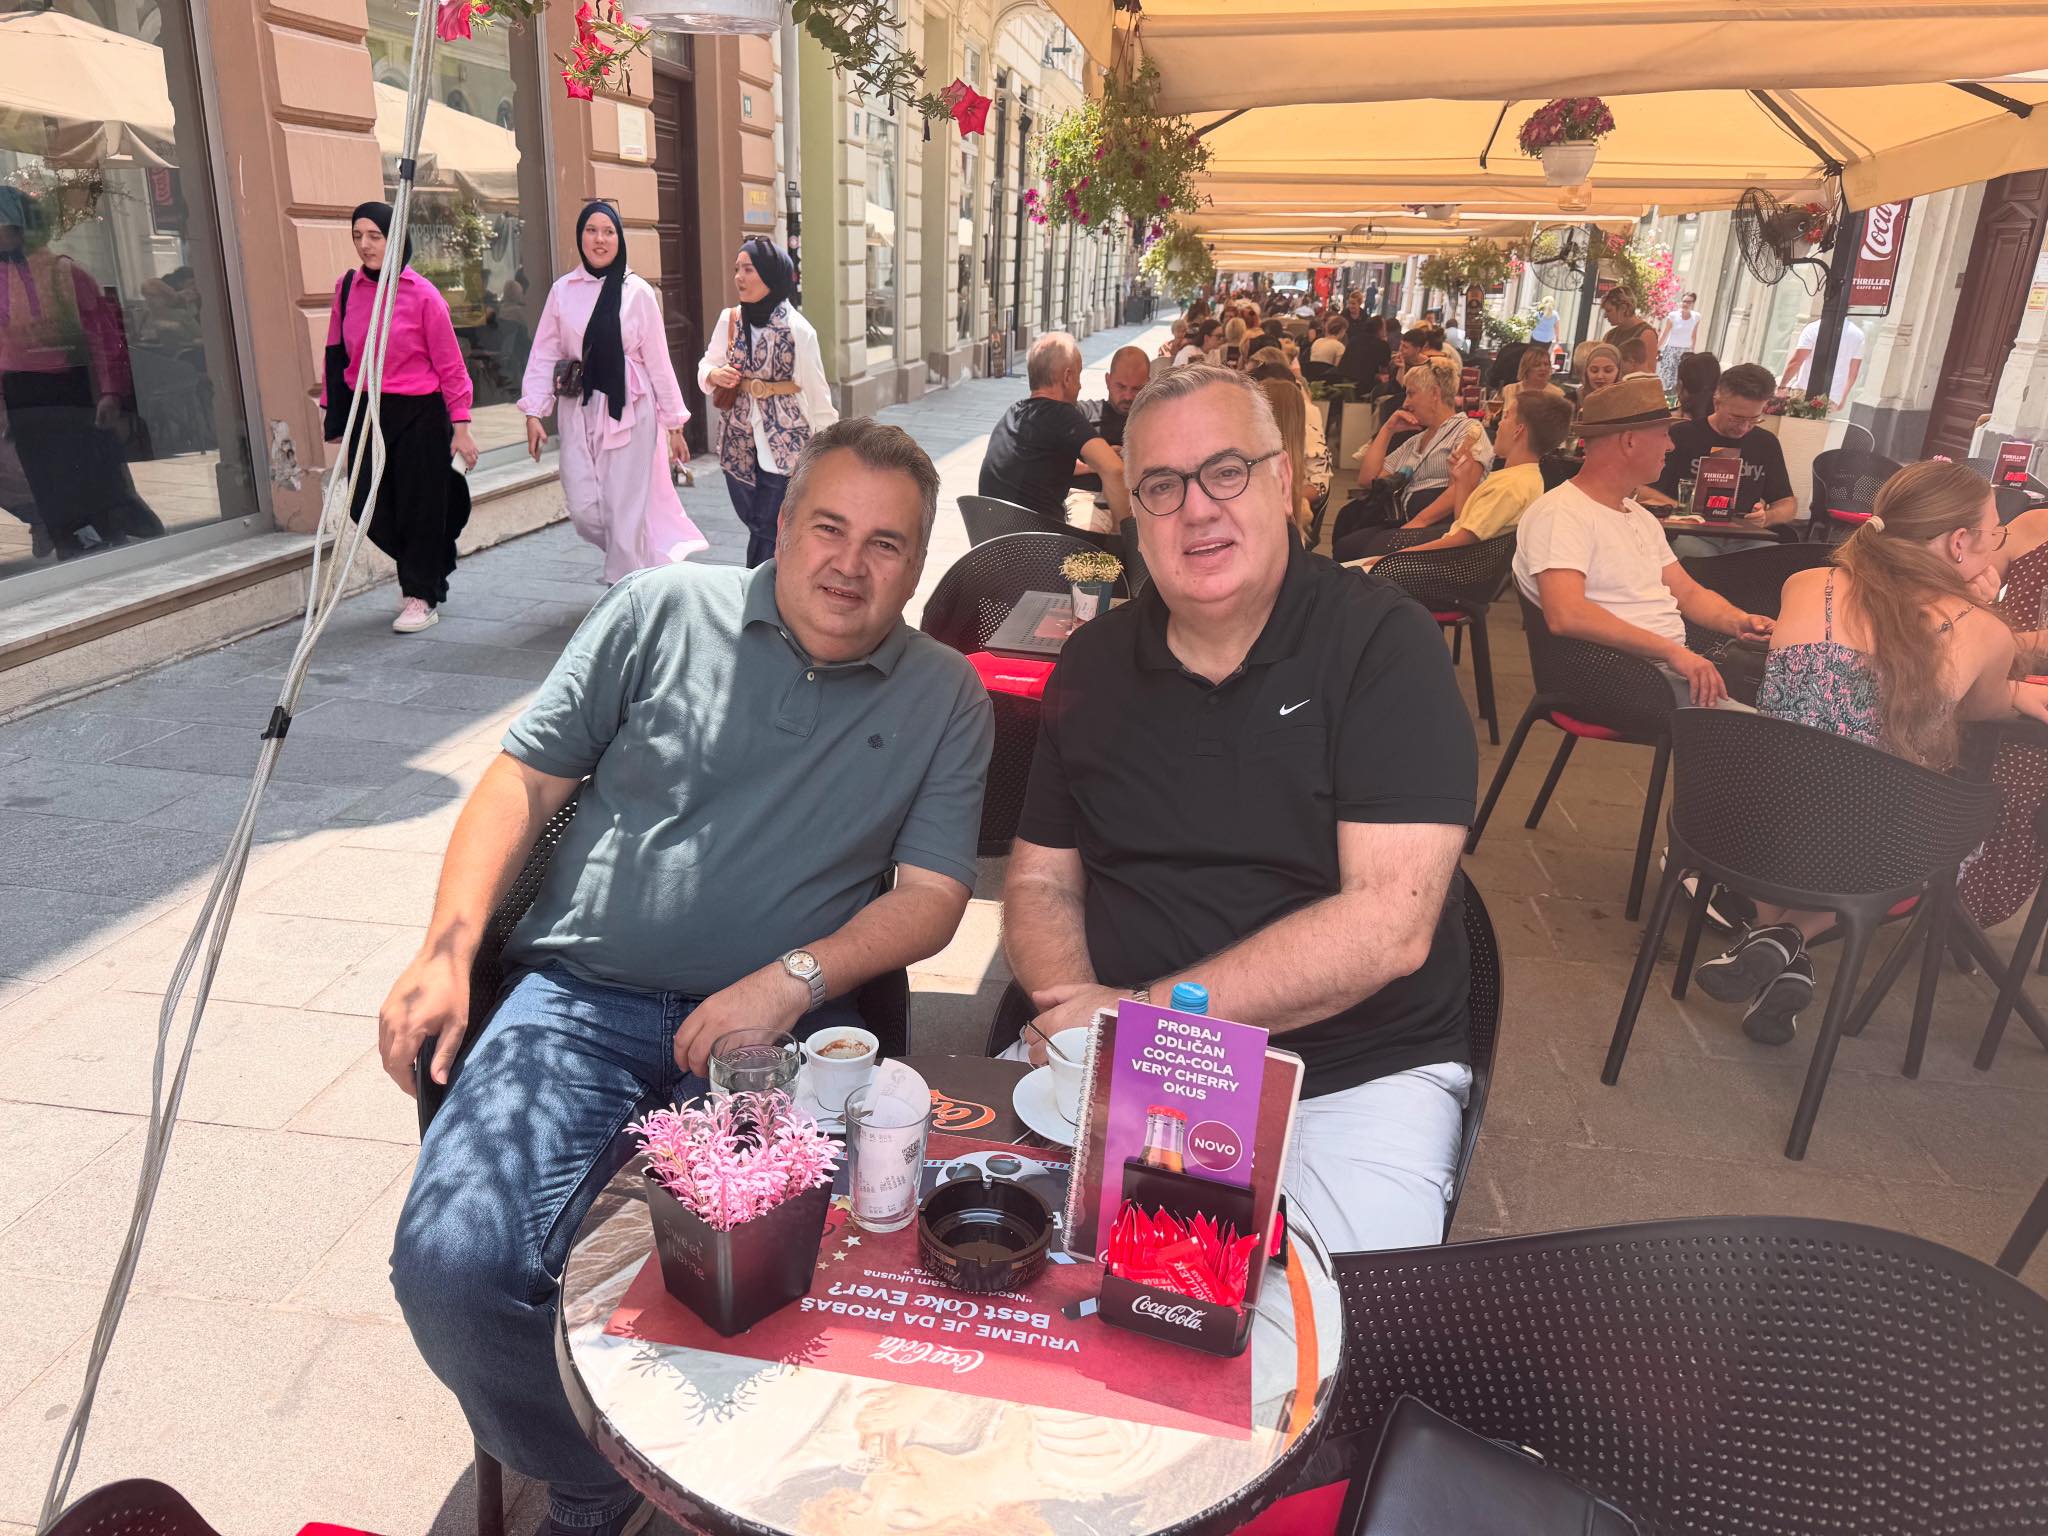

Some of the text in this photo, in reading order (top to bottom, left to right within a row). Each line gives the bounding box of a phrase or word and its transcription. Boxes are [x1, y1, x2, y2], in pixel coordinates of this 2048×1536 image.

[1860, 202, 1902, 261] Coca
[1852, 278, 1890, 286] THRILLER
[1691, 458, 1765, 481] Sdry.
[1157, 1018, 1222, 1042] PROBAJ
[1154, 1034, 1225, 1059] ODLIČAN
[1131, 1058, 1240, 1093] VERY CHERRY
[1143, 1047, 1234, 1077] COCA-COLA
[1163, 1081, 1207, 1100] OKUS
[1194, 1137, 1236, 1156] NOVO
[863, 1269, 914, 1284] ukusna
[917, 1277, 948, 1289] sam
[1174, 1260, 1210, 1303] RILLER
[827, 1282, 1051, 1330] Best Coke Ever?
[1131, 1295, 1208, 1332] Coca-Cola
[800, 1297, 1081, 1352] VRIJEME JE DA PROBAŠ
[868, 1335, 985, 1374] Coca-Cola
